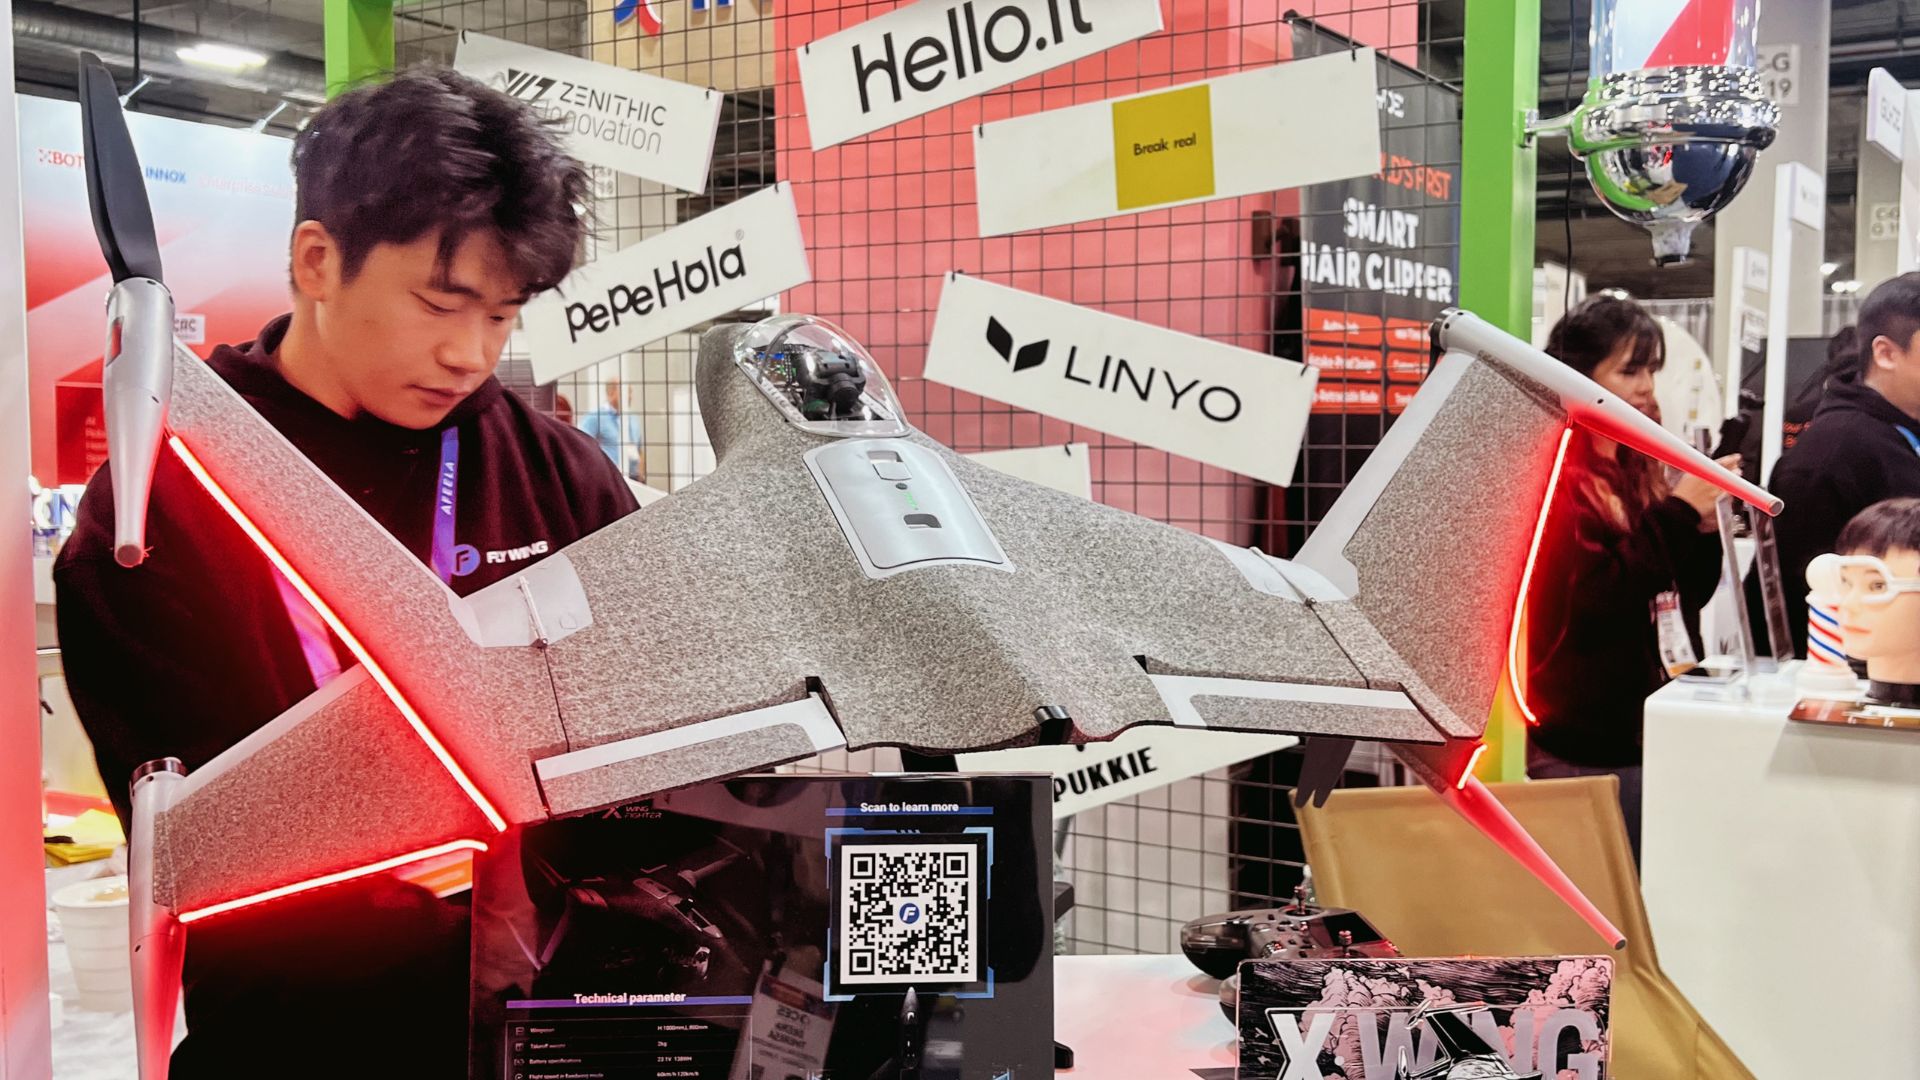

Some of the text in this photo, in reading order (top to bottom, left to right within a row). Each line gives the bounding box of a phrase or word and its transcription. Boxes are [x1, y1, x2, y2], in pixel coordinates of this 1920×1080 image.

[560, 82, 667, 126] ZENITHIC
[1133, 132, 1197, 156] Break real
[145, 166, 187, 184] INNOX
[1343, 197, 1419, 249] SMART
[1301, 240, 1452, 304] HAIR CLIPPER
[1064, 345, 1241, 422] LINYO
[441, 462, 455, 515] AFEELA
[1053, 746, 1158, 803] PUKKIE
[860, 802, 959, 813] Scan to learn more
[573, 992, 687, 1005] Technical parameter
[1271, 1009, 1602, 1080] X WNG
